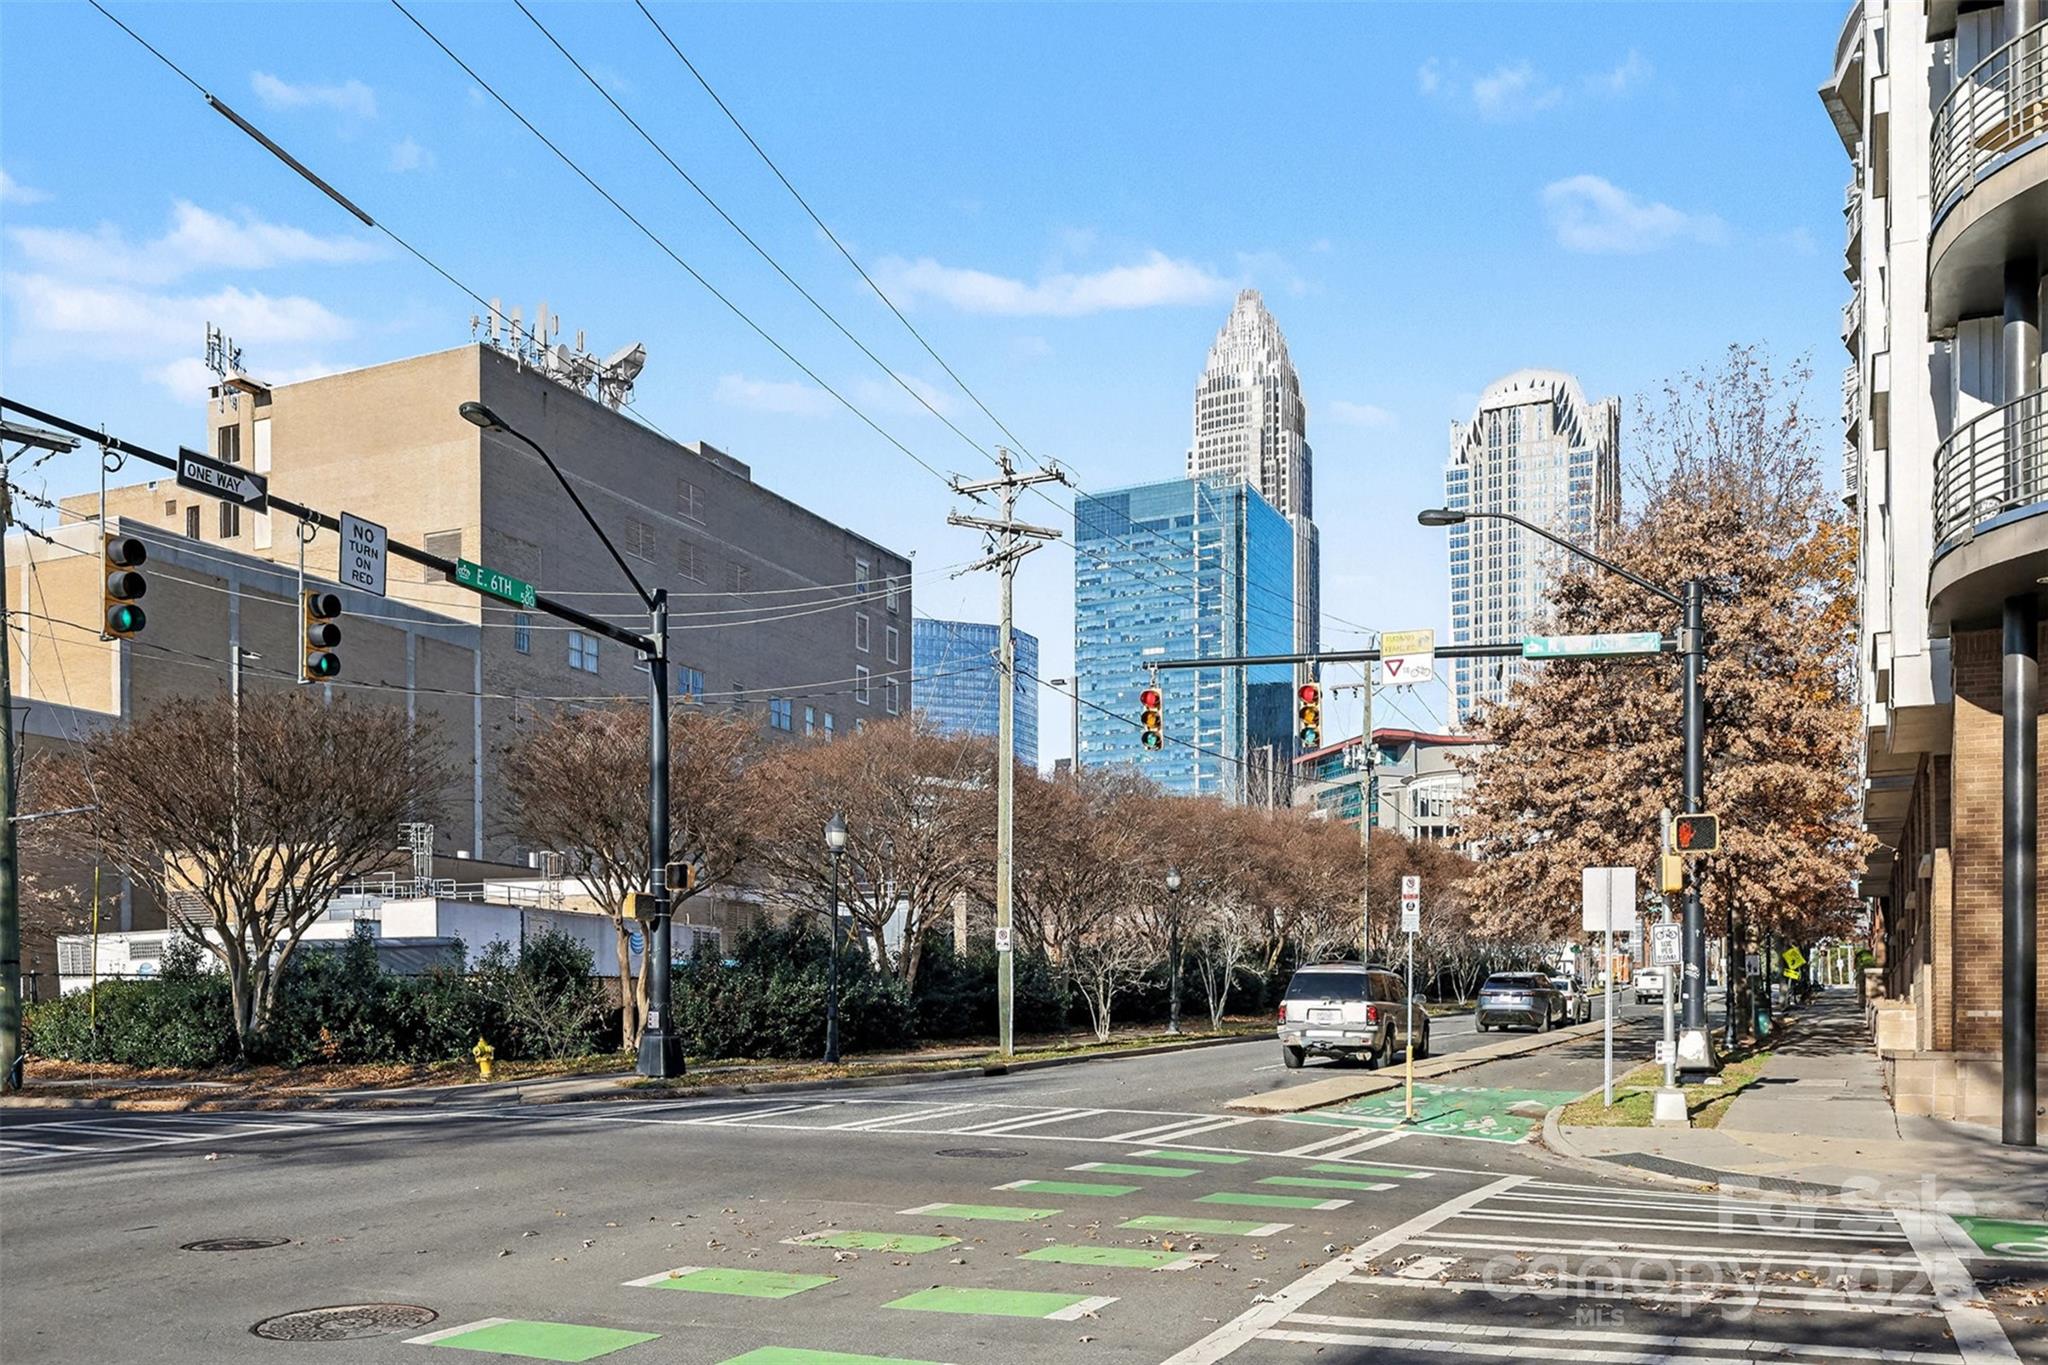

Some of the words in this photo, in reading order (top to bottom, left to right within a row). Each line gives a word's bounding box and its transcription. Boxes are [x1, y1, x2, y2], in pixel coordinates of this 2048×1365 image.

[187, 463, 212, 483] ONE
[216, 472, 242, 492] WAY
[353, 524, 375, 543] NO
[349, 540, 379, 560] TURN
[355, 556, 372, 571] ON
[351, 569, 374, 585] RED
[476, 568, 488, 587] E.
[490, 574, 512, 596] 6TH
